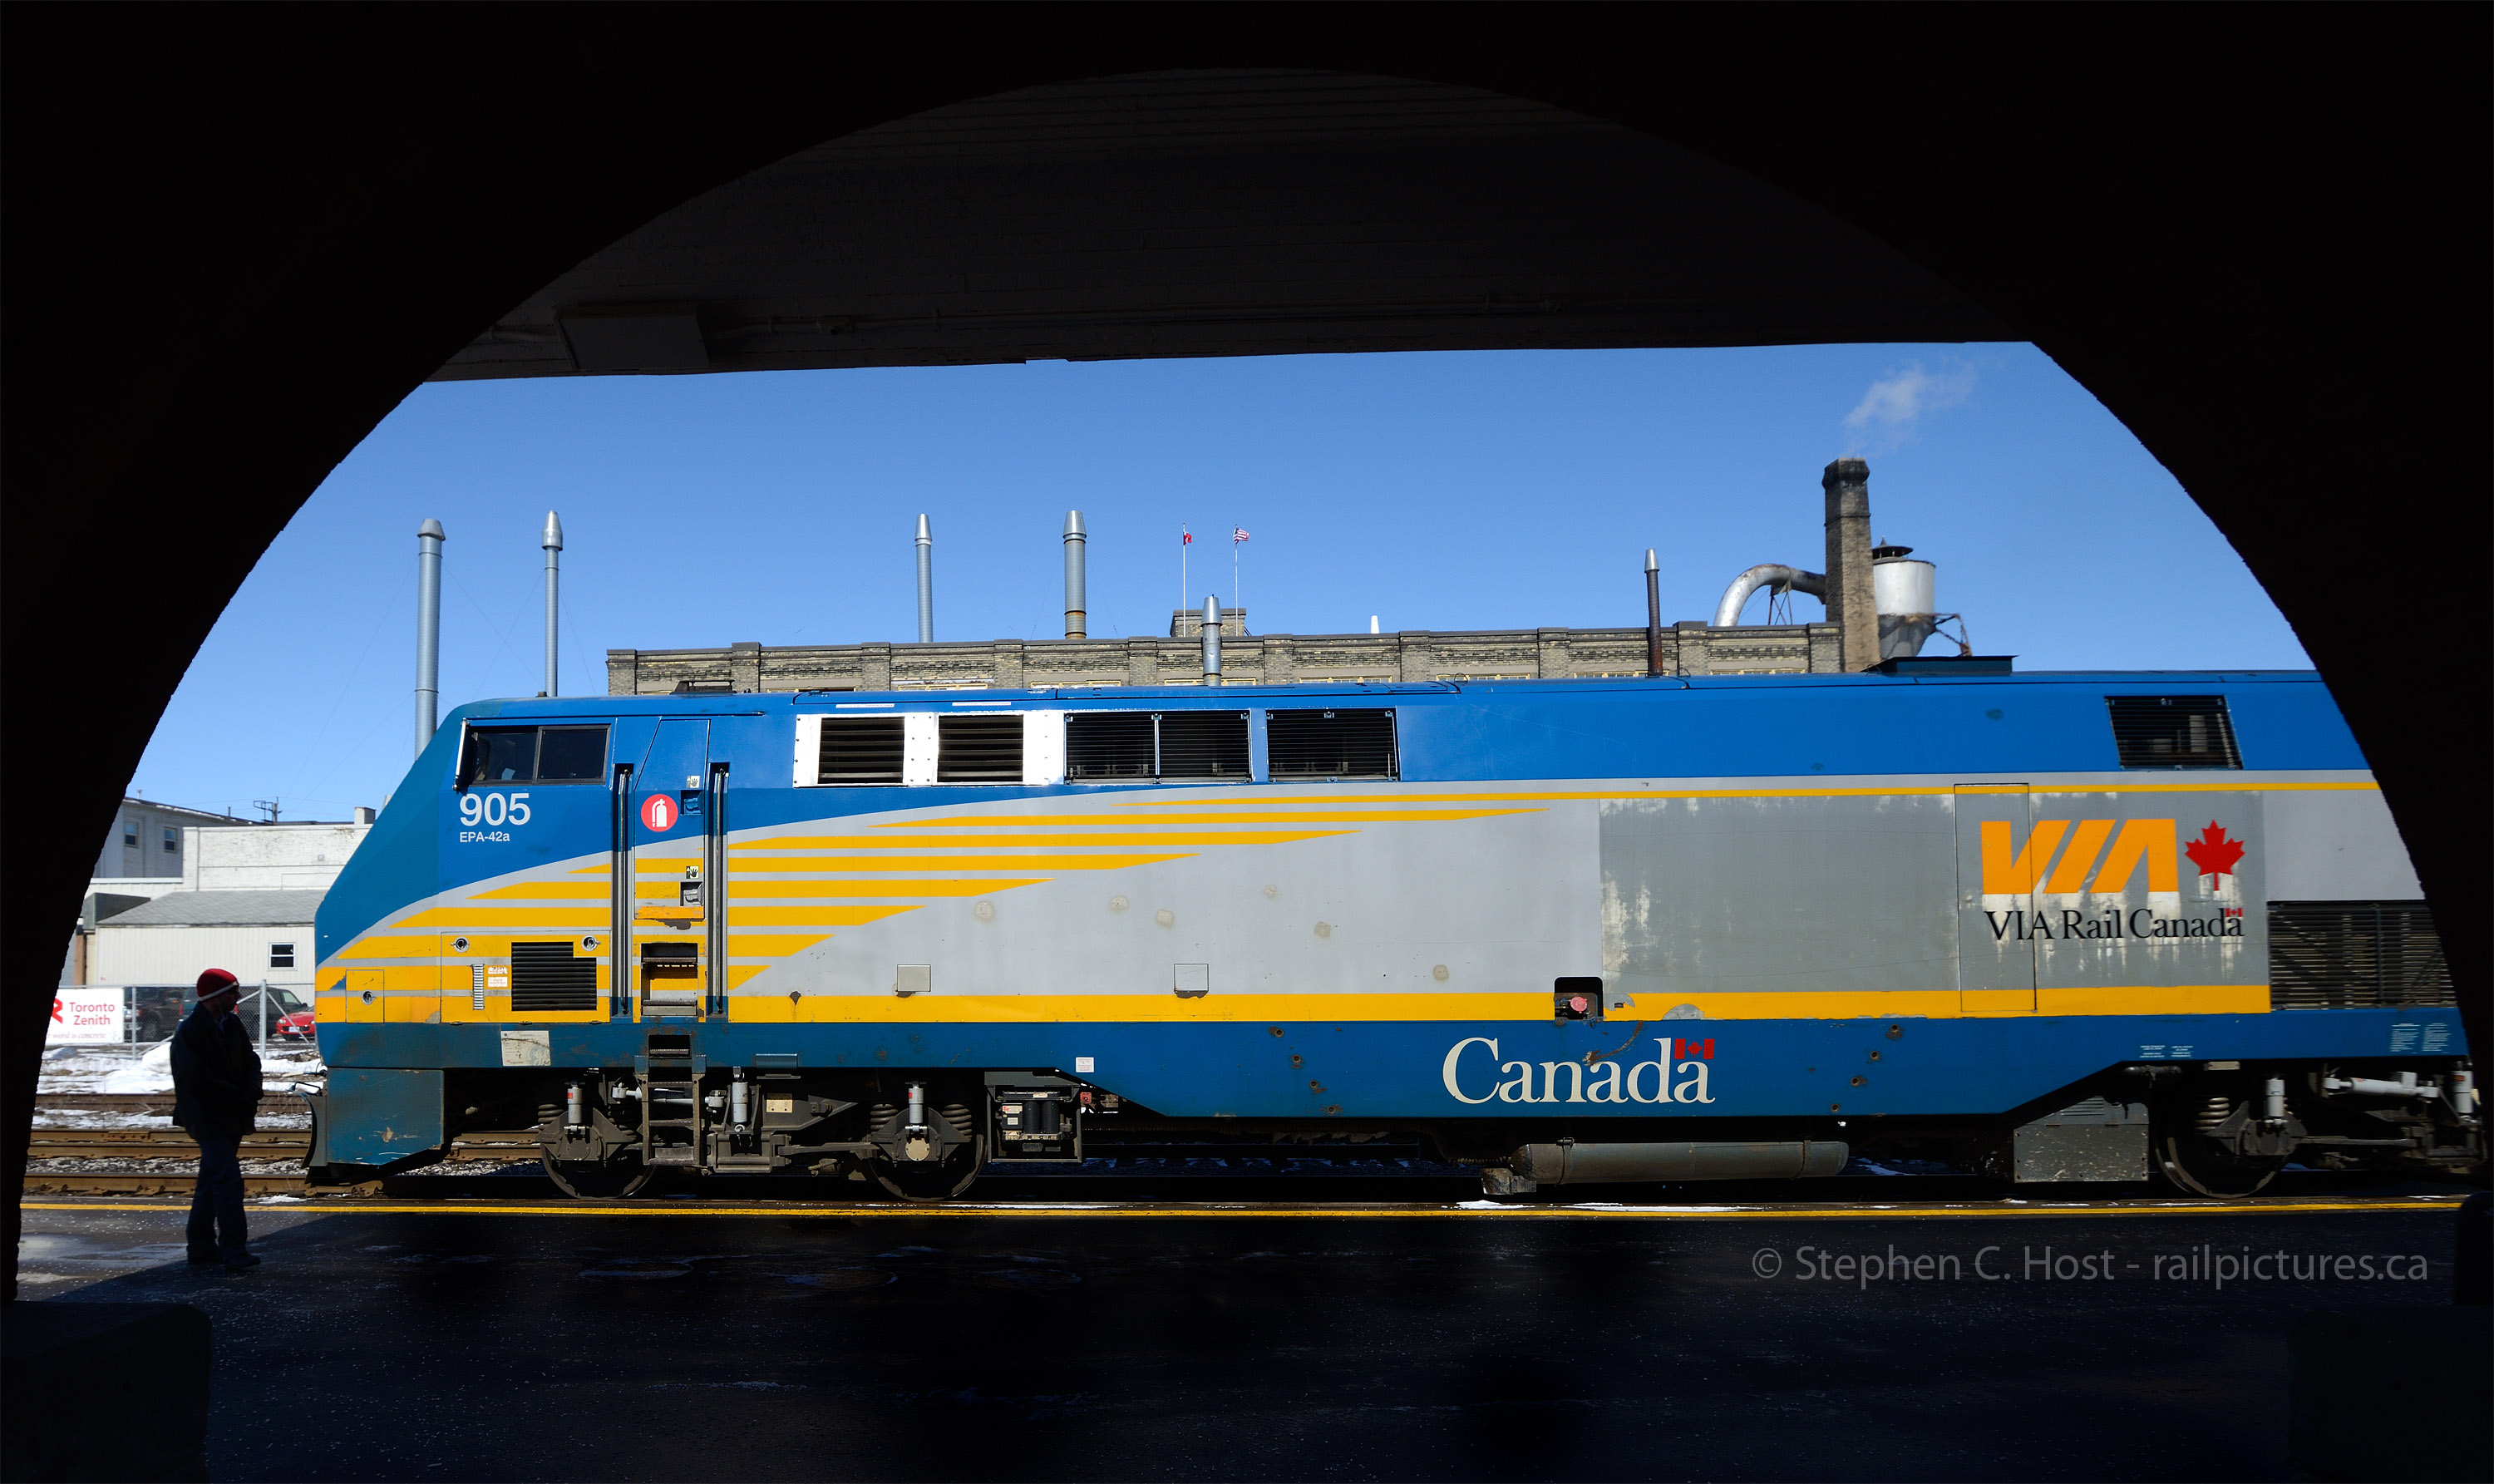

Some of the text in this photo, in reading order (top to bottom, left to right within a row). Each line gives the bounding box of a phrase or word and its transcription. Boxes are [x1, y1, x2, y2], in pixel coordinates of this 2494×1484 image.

[459, 792, 531, 826] 905
[459, 831, 510, 843] EPA-42a
[1980, 818, 2179, 895] VIA
[1984, 908, 2245, 940] VIA Rail Canada
[68, 1002, 115, 1012] Toronto
[73, 1014, 111, 1025] Zenith
[1442, 1037, 1716, 1104] Canada
